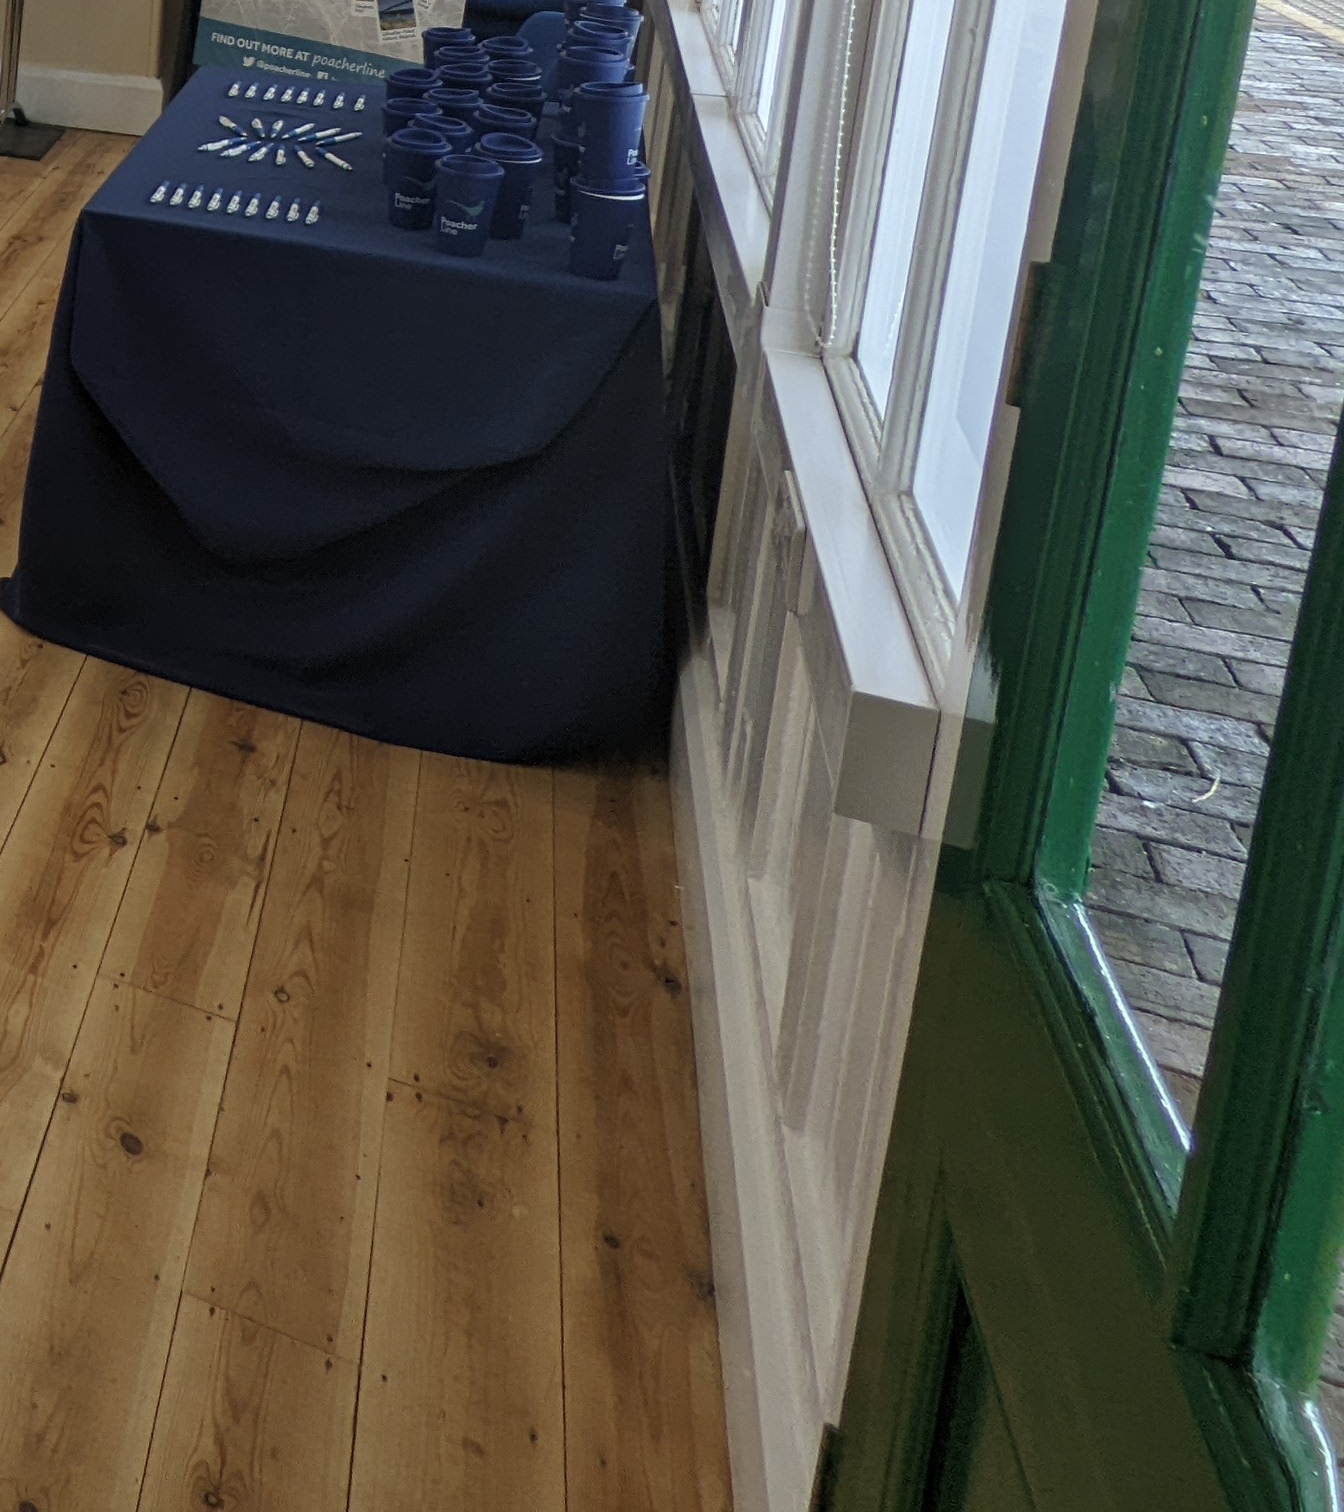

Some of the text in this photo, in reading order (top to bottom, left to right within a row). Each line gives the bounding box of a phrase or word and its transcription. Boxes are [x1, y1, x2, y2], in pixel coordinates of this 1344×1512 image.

[211, 32, 386, 79] FIND OUT MORE AT poacherline
[395, 193, 430, 204] Poacher
[441, 216, 478, 230] Poacher
[441, 226, 458, 236] Line
